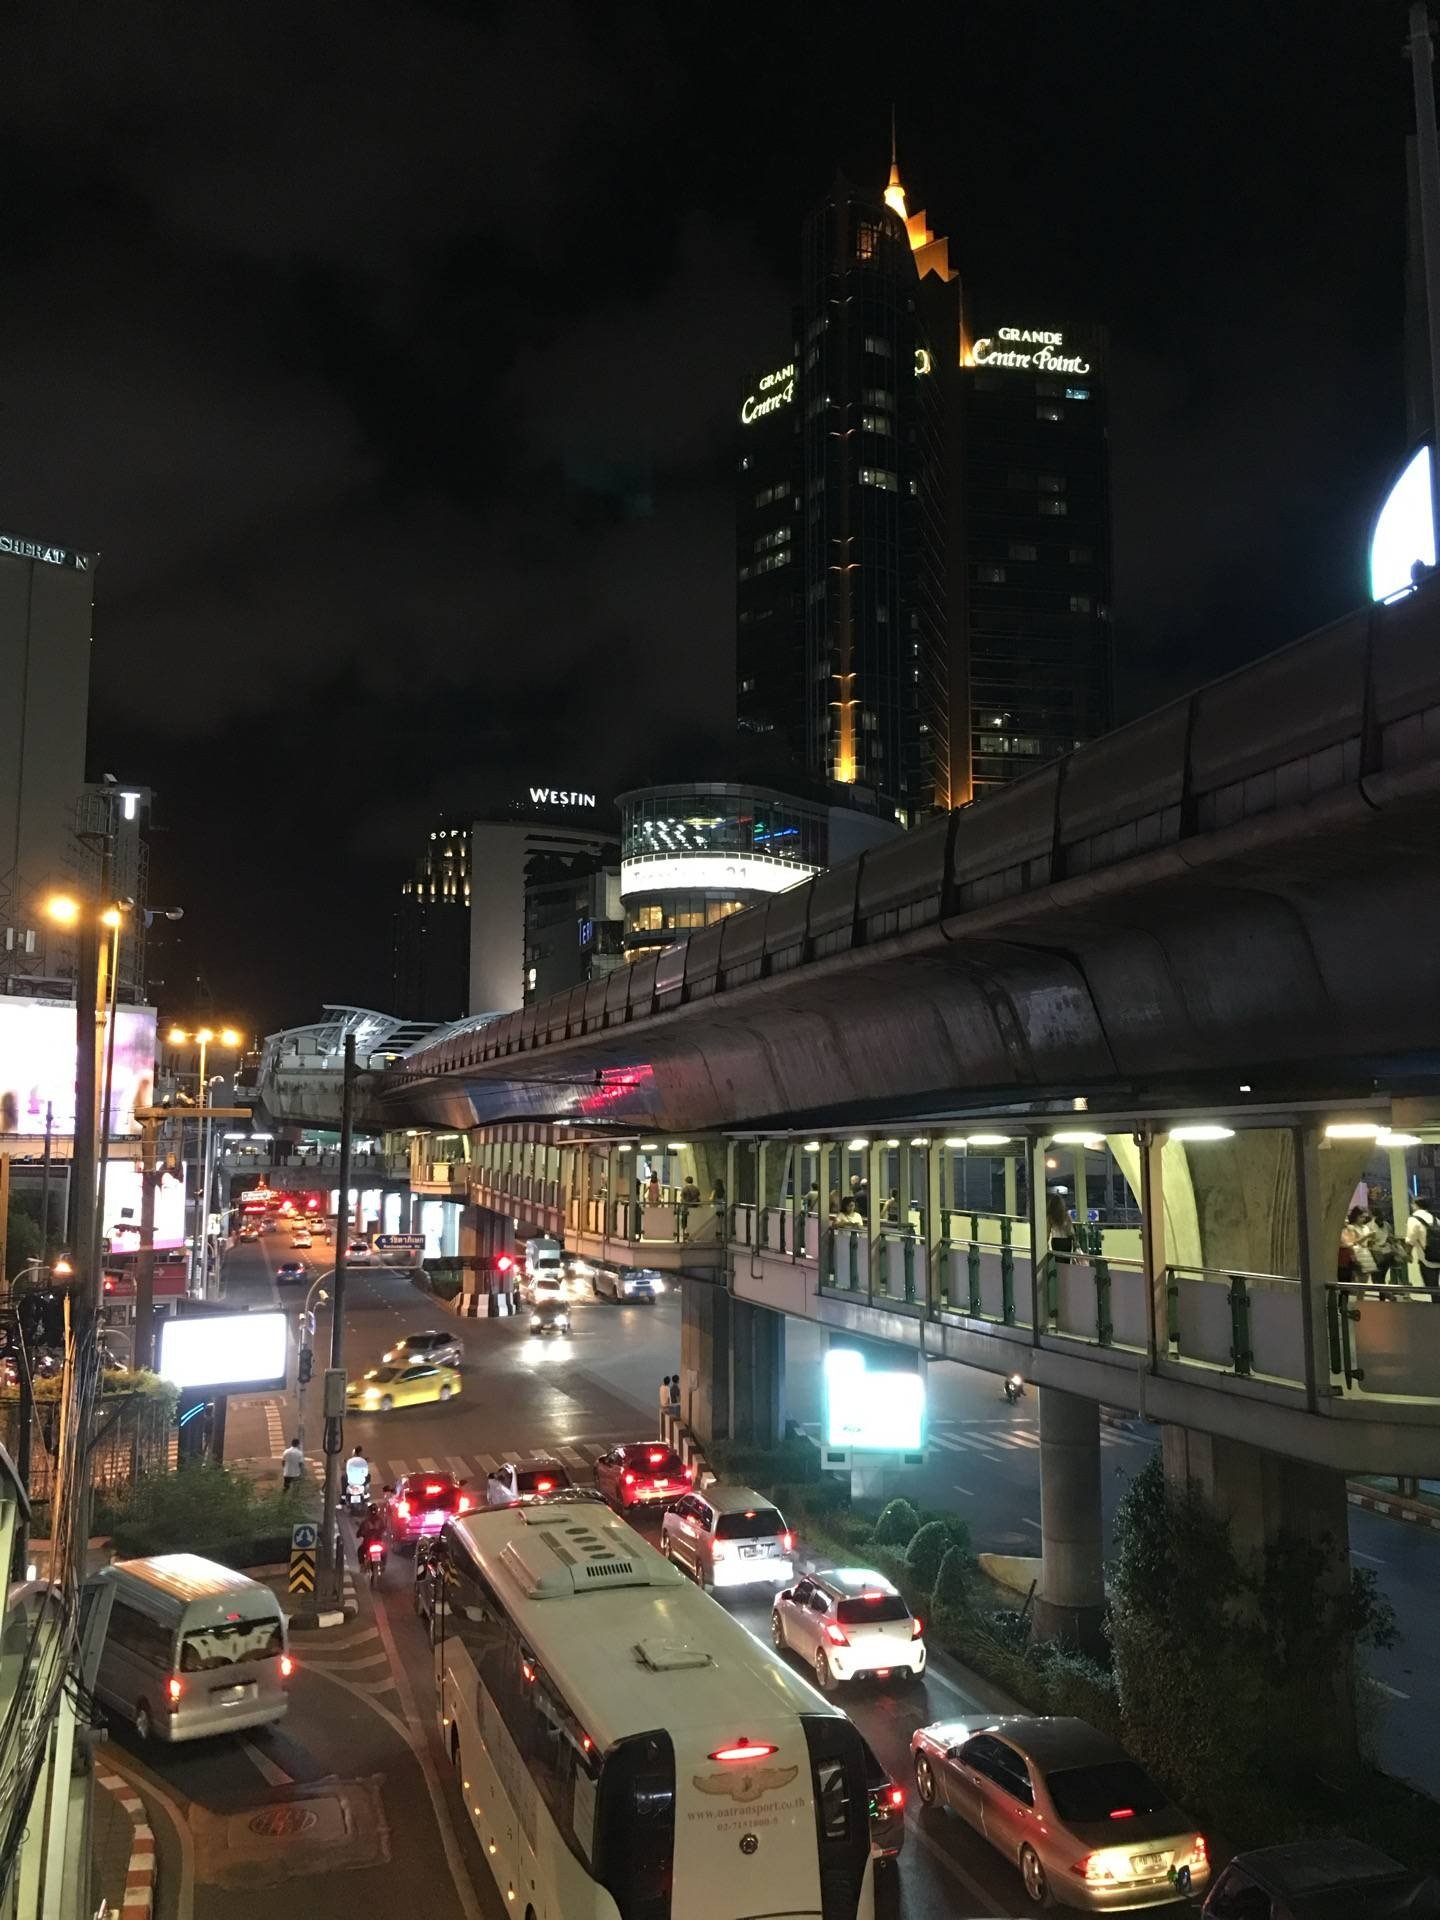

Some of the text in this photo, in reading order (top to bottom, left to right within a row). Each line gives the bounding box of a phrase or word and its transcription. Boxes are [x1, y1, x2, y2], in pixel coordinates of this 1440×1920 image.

[998, 327, 1063, 346] GRANDE
[972, 338, 1090, 374] Centre Point
[741, 393, 783, 424] Centre
[529, 787, 596, 808] WESTIN
[430, 829, 474, 840] SOFI
